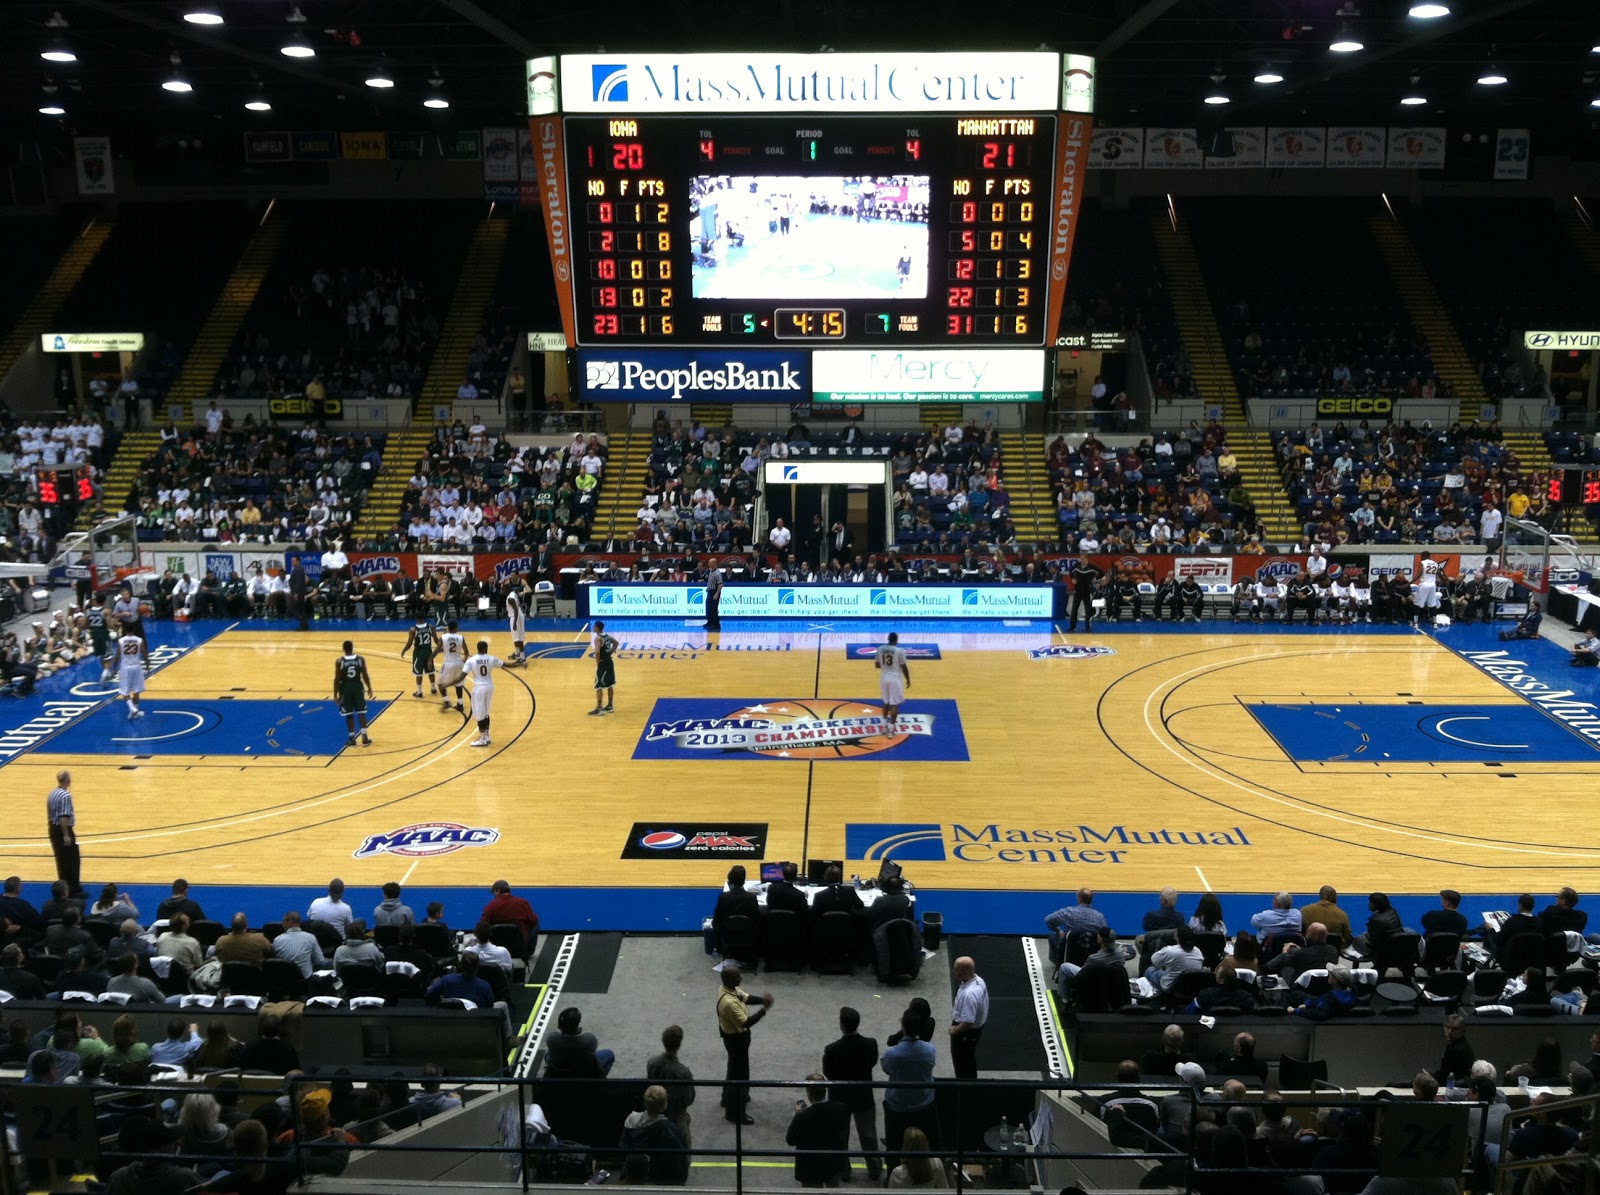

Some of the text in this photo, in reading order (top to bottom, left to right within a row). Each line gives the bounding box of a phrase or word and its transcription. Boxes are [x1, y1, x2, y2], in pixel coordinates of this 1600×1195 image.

[645, 63, 1024, 101] MassMutual Center
[610, 121, 637, 137] IONA
[699, 130, 713, 138] TOL
[796, 130, 822, 138] PERIOD
[906, 129, 920, 137] TOL
[957, 119, 1034, 136] MANHATTAN
[346, 140, 380, 151] IONA
[700, 140, 714, 160] 4
[765, 147, 784, 155] GOAL
[810, 140, 817, 160] 1
[834, 147, 853, 155] GOAL
[906, 140, 920, 160] 4
[1499, 138, 1527, 161] 23
[612, 143, 644, 170] 20
[982, 143, 1014, 169] 21
[539, 121, 564, 256] Sheraton
[588, 180, 665, 196] NO F PTS
[953, 179, 1030, 196] NO F PTS
[1057, 120, 1083, 255] Sheraton
[600, 203, 669, 224] 0 1 2
[963, 203, 1032, 223] 0 0 0
[601, 231, 670, 251] 2 1 8
[961, 231, 1031, 251] 5 0 4
[598, 259, 671, 280] 10 0 0
[956, 259, 1030, 280] 12 1 3
[600, 287, 672, 308] 13 0 2
[948, 287, 1029, 307] 22 1 3
[594, 315, 674, 335] 23 1 6
[702, 315, 722, 323] TEAM
[702, 323, 722, 332] FOULS
[742, 314, 755, 334] 5
[792, 312, 843, 336] 4:15
[877, 314, 890, 333] 7
[898, 323, 919, 332] FOULS
[899, 315, 918, 323] TEAM
[948, 315, 1028, 335] 31 1 6
[529, 342, 546, 351] HNE
[869, 353, 989, 388] Mercy
[622, 360, 801, 399] PeoplesBank
[844, 392, 870, 400] mission
[917, 393, 942, 402] passion
[979, 393, 1029, 402] mercycares.com
[1318, 398, 1392, 414] GEICO
[350, 557, 398, 580] MAAC
[496, 556, 533, 583] MAA
[1179, 563, 1229, 576] ESPN
[1425, 565, 1438, 575] 22
[616, 593, 678, 604] MassMutual
[797, 593, 859, 605] MassMutual
[888, 594, 951, 605] MassMutual
[981, 594, 1044, 605] MassMutual
[88, 615, 102, 627] 22
[417, 633, 432, 645] 12
[449, 642, 457, 653] 2
[123, 643, 138, 656] 23
[881, 654, 894, 667] 13
[347, 665, 357, 679] 5
[479, 665, 488, 677] 0
[647, 718, 776, 741] MAAC
[685, 733, 747, 746] 2013
[354, 827, 501, 858] MAAC
[686, 836, 758, 847] MAX
[949, 824, 1252, 846] MassMutual
[952, 843, 1129, 864] Center
